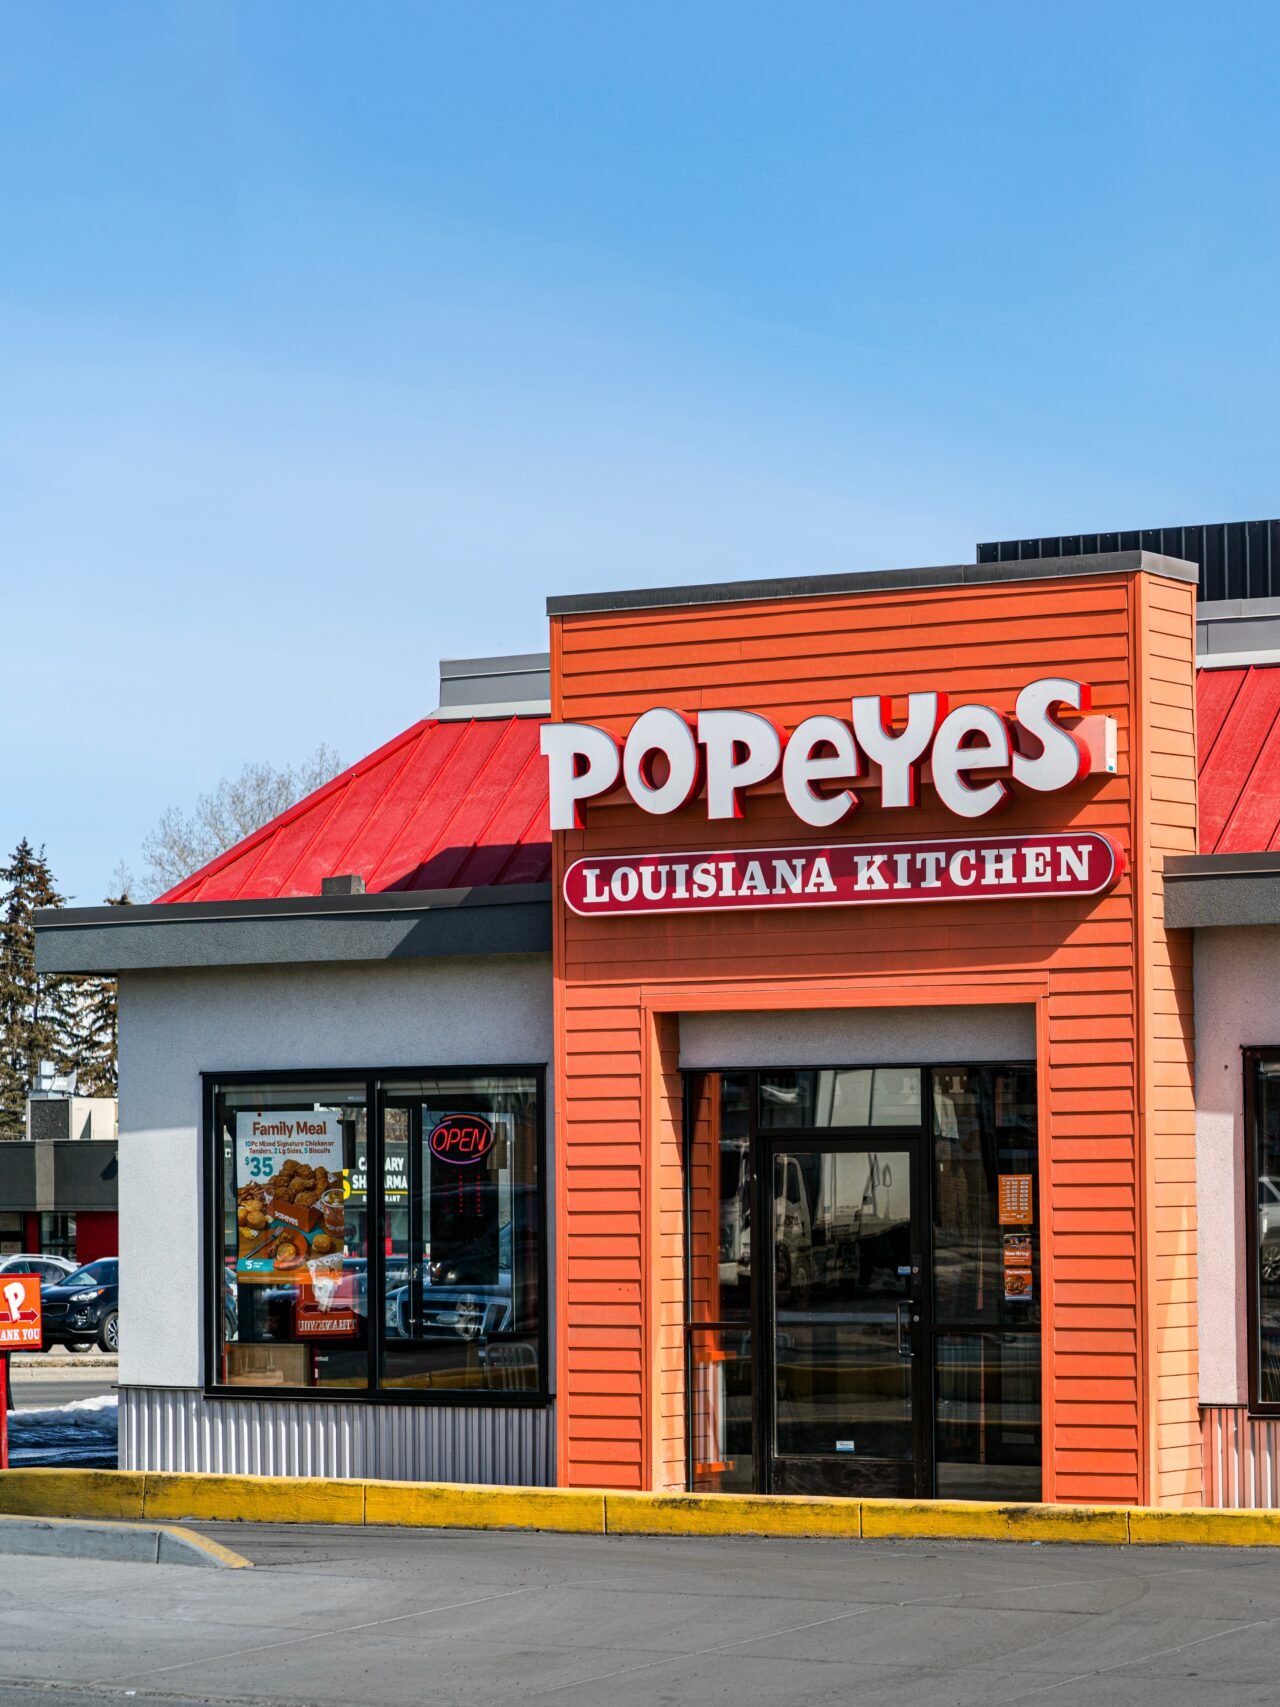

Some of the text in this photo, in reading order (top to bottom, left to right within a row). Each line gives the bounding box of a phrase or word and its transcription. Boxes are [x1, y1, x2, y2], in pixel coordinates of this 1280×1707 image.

[582, 845, 1094, 904] LOUISIANA KITCHEN
[252, 1121, 327, 1138] Family Meal
[432, 1128, 488, 1151] OPEN
[276, 1140, 304, 1149] Signature
[245, 1157, 274, 1177] $35
[4, 1281, 25, 1321] P
[0, 1328, 40, 1341] ANK YOU
